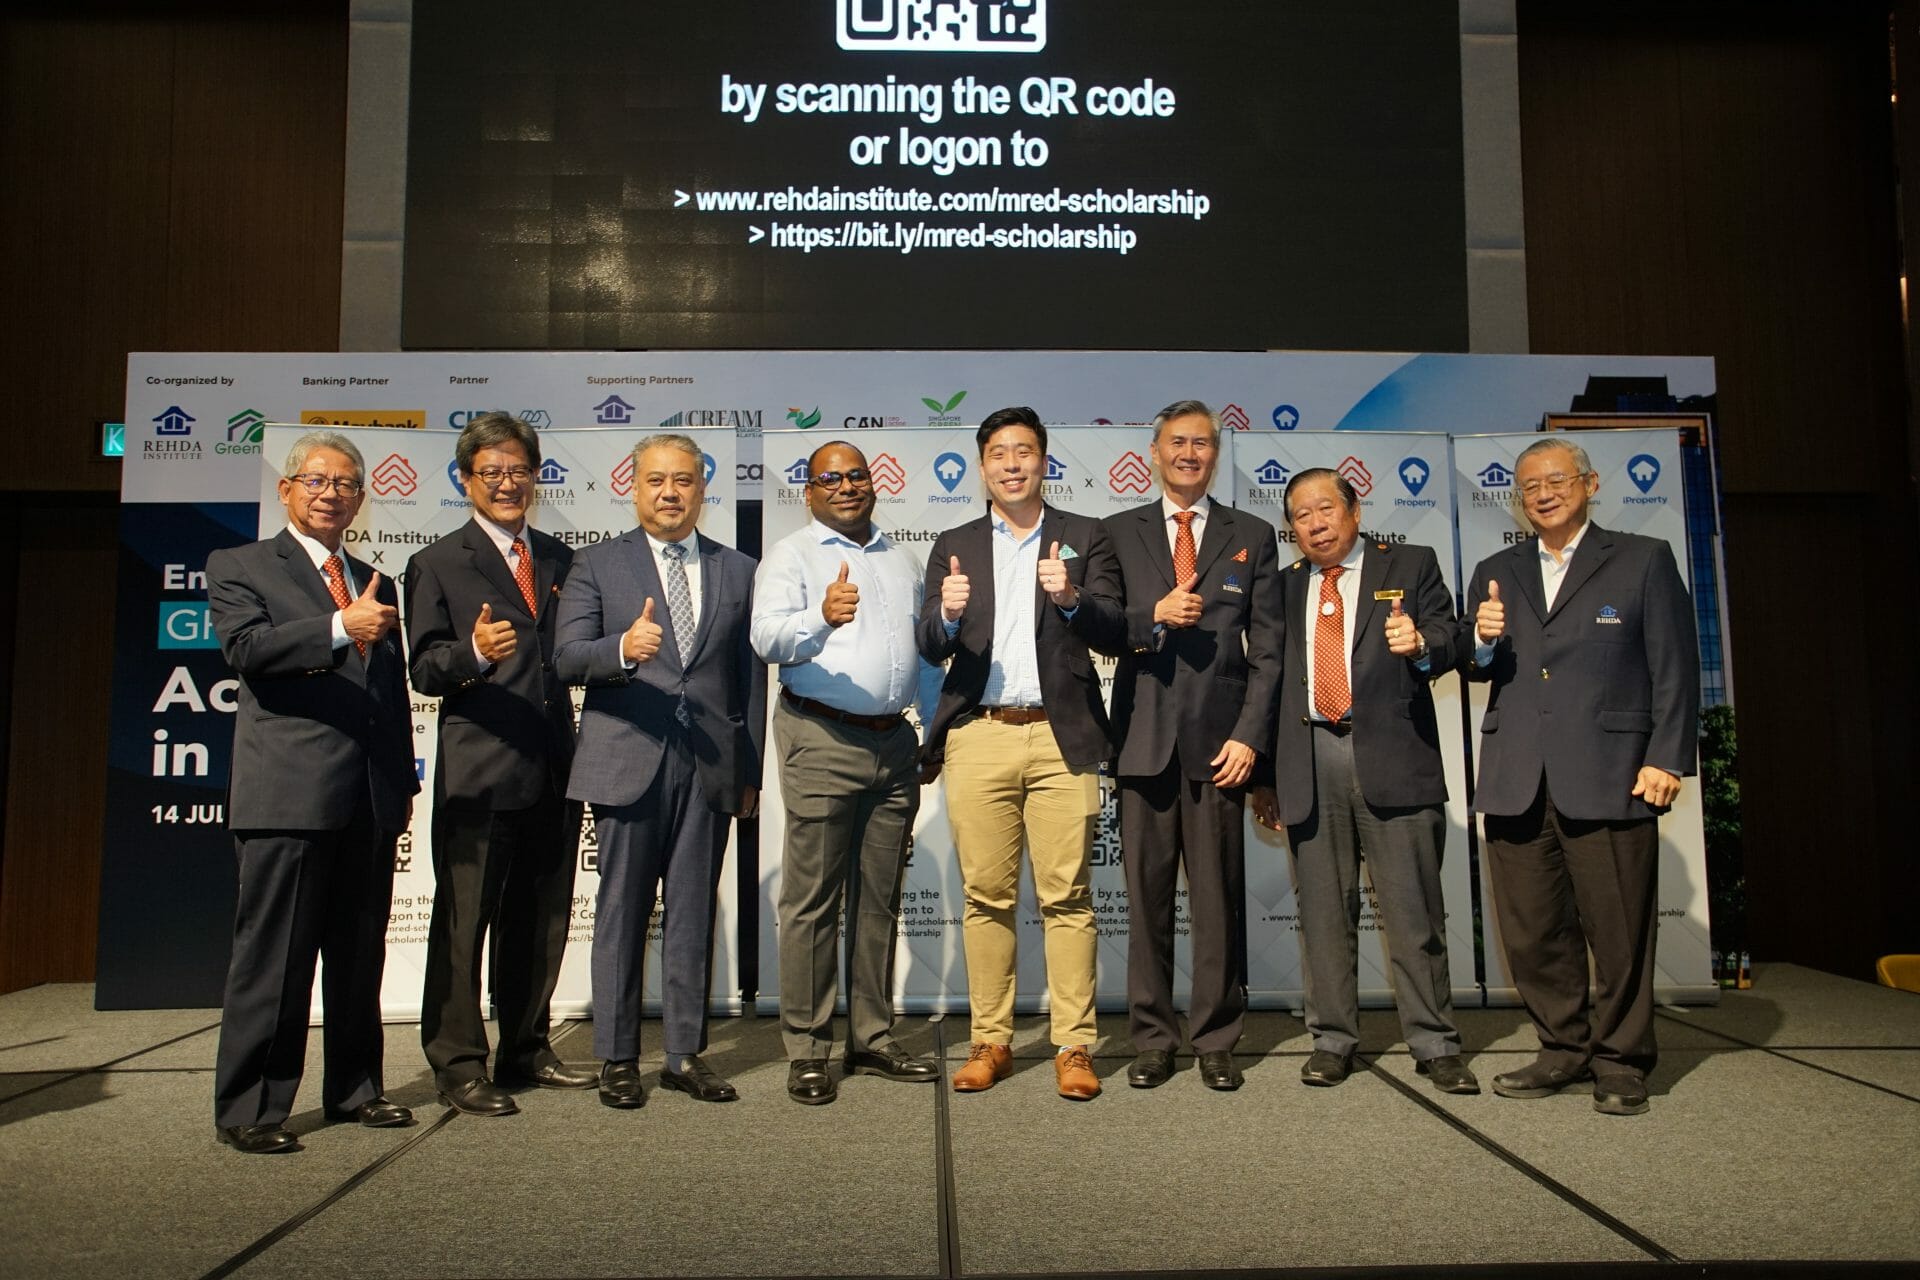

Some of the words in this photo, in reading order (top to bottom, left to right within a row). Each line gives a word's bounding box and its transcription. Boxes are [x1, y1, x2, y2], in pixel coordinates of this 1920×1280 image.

[720, 74, 767, 123] by
[775, 75, 943, 124] scanning
[952, 76, 1011, 115] the
[1018, 78, 1079, 118] QR
[1086, 78, 1176, 117] code
[849, 134, 890, 166] or
[899, 127, 1002, 176] logon
[1010, 130, 1049, 168] to
[696, 186, 1211, 220] www.rehdainstitute.com/mred-scholarship
[770, 223, 1137, 254] https://bit.ly/mred-scholarship
[146, 375, 218, 387] Co-organized
[221, 375, 234, 387] by
[302, 376, 346, 388] Banking
[349, 376, 389, 386] Partner
[449, 375, 489, 385] Partner
[586, 375, 646, 387] Supporting
[649, 375, 694, 385] Partners
[143, 440, 203, 452] REHDA
[214, 442, 262, 455] Green
[143, 452, 203, 460] INSTITUTE
[535, 489, 576, 499] EHDA
[1042, 485, 1074, 495] HDA
[370, 498, 417, 506] PropertyGuru
[928, 495, 972, 505] iProperty
[1394, 498, 1436, 508] iProperty
[1622, 496, 1668, 505] iProperty
[378, 530, 441, 545] Institut
[887, 529, 939, 542] stitute
[1503, 532, 1537, 544] REH
[163, 563, 208, 590] En
[1595, 616, 1622, 624] REHDA
[152, 665, 241, 714] Ac
[153, 728, 209, 777] in
[151, 804, 180, 824] 14
[920, 889, 940, 899] the
[921, 904, 934, 915] to
